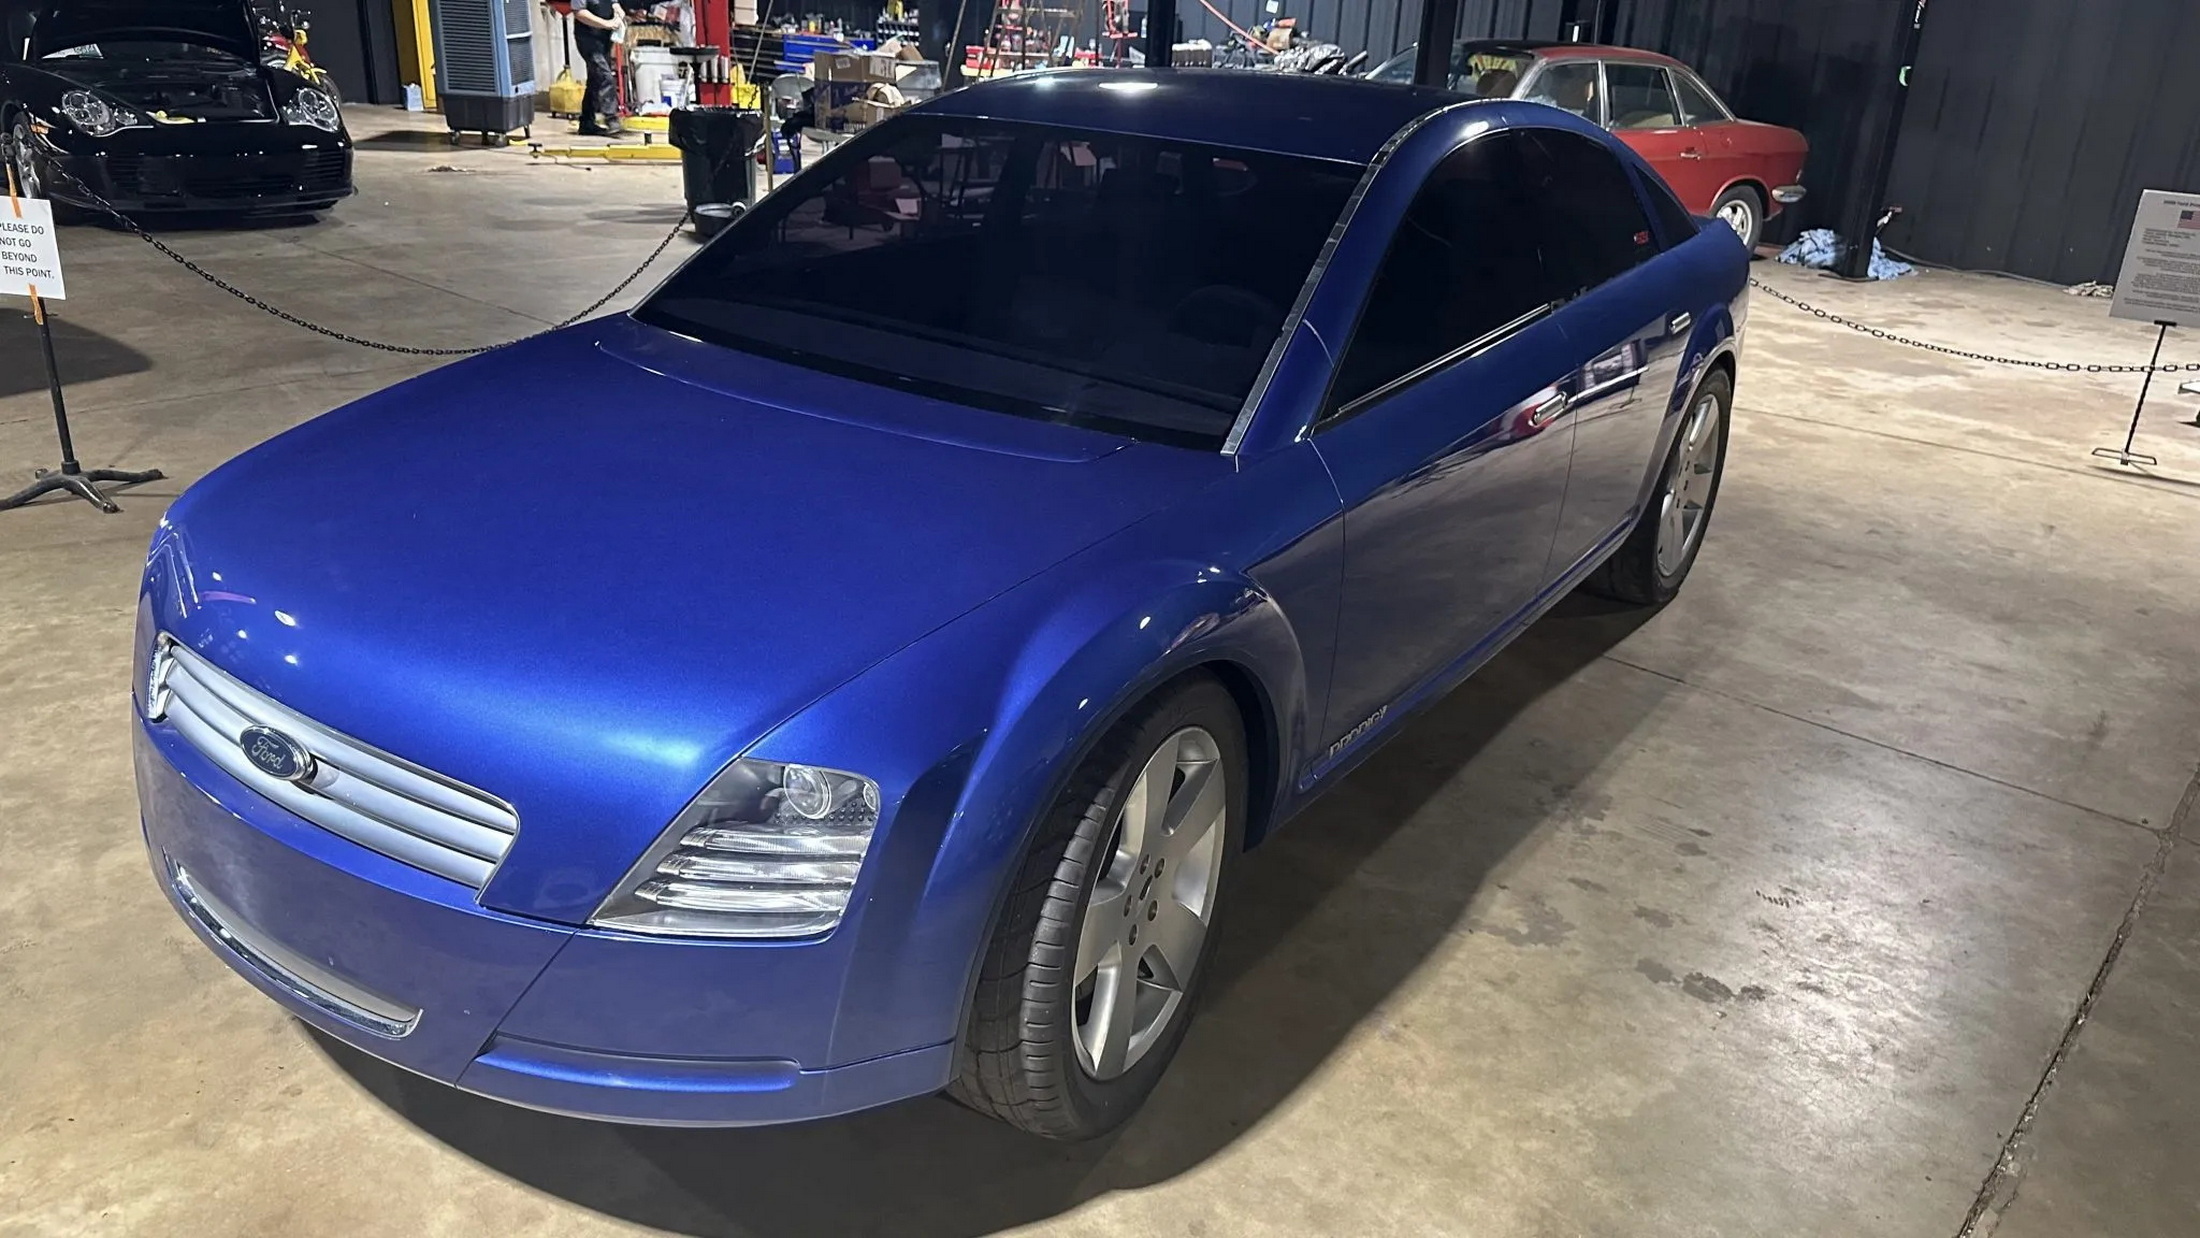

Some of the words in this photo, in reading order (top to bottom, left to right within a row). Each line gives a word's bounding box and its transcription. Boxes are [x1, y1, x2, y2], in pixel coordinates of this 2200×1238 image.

[31, 225, 44, 235] DO
[0, 237, 16, 247] NOT
[18, 238, 32, 248] GO
[1, 251, 38, 263] BEYOND
[3, 265, 25, 276] THIS
[25, 267, 55, 279] POINT.
[251, 735, 287, 770] Ford
